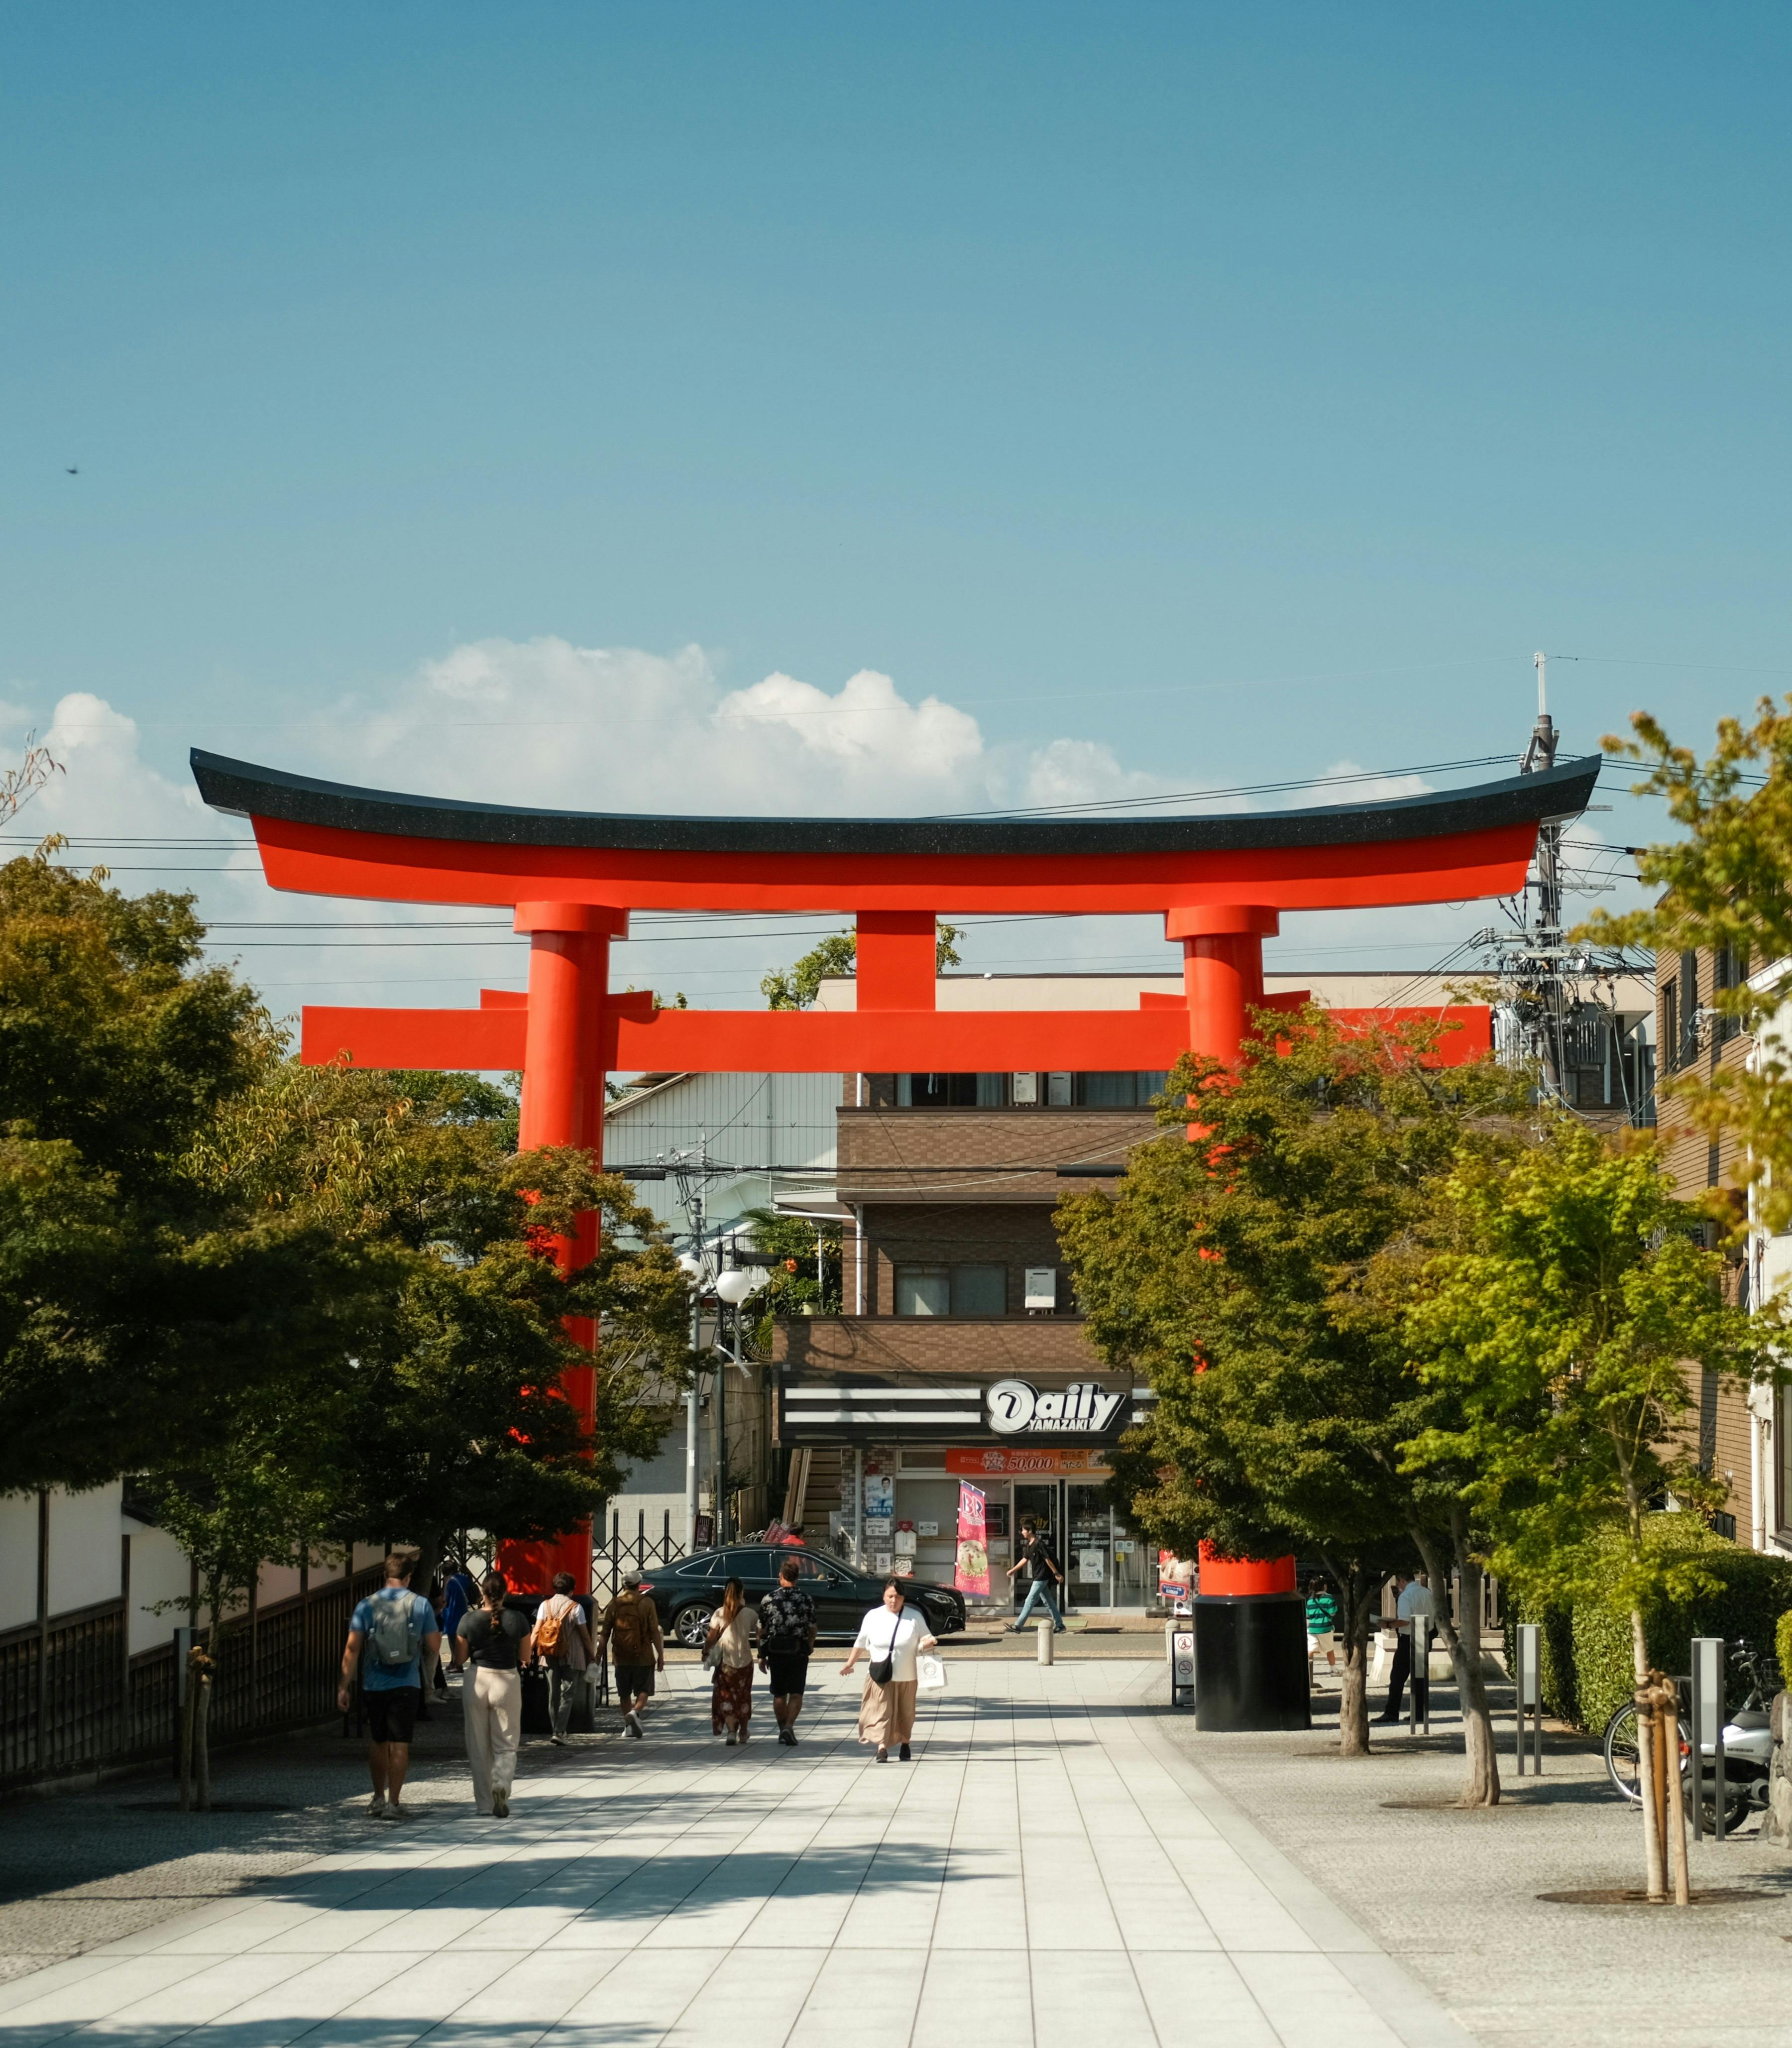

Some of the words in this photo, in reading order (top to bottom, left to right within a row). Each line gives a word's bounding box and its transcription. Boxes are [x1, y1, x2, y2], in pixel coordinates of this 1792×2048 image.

[988, 1380, 1121, 1432] Daily
[1030, 1419, 1087, 1430] YAMAZAKI
[1008, 1457, 1053, 1471] 50,000
[962, 1492, 983, 1518] BR
